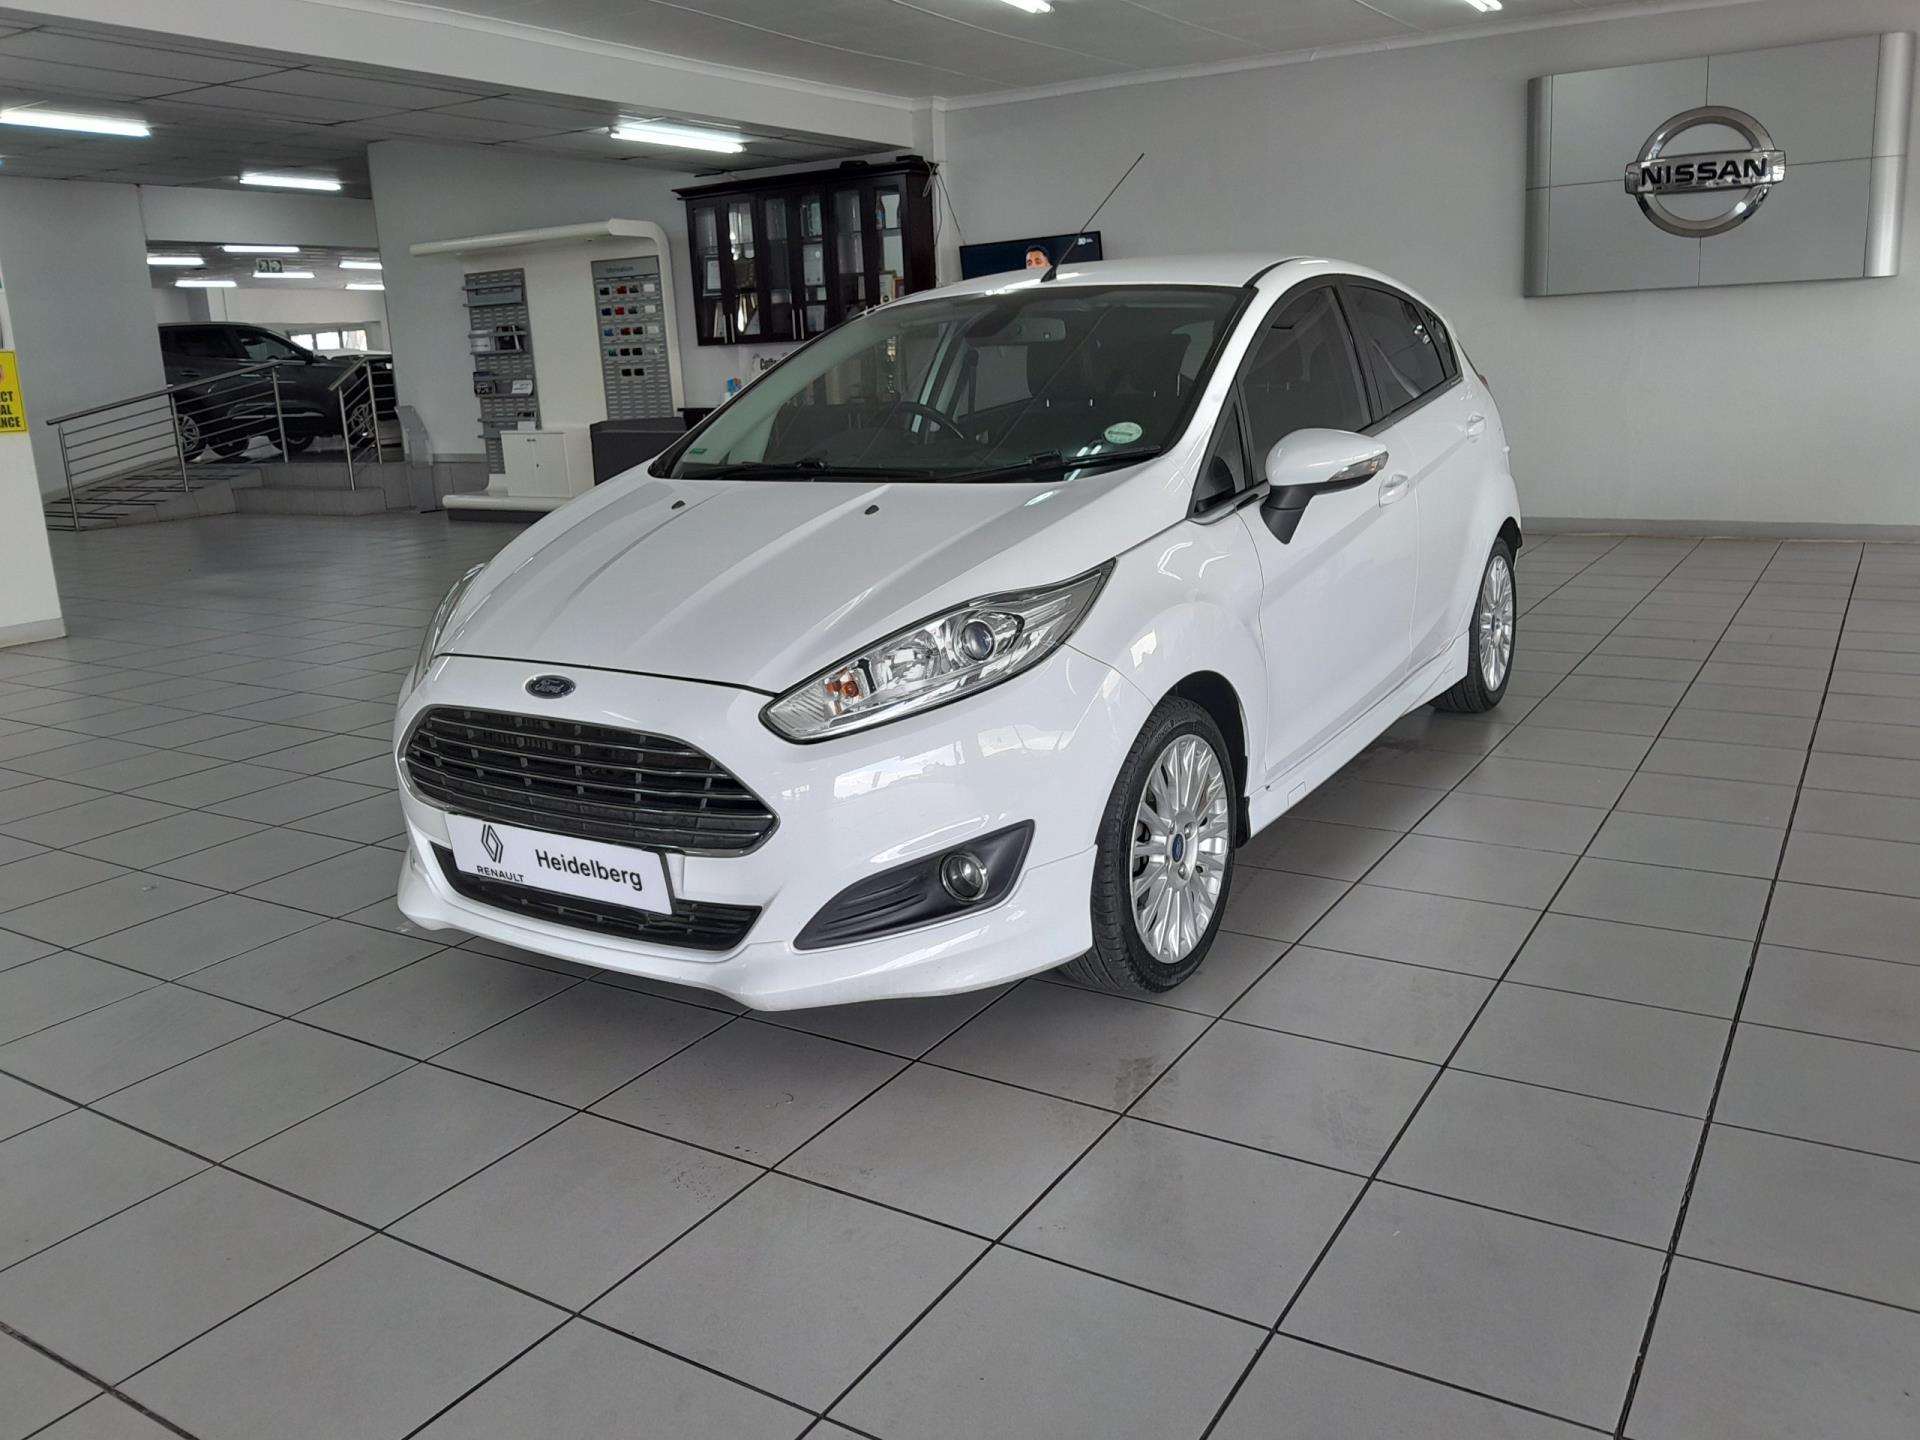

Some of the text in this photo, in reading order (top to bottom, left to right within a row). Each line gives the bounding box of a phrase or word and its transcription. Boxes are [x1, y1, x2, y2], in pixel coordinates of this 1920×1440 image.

[1641, 158, 1768, 185] NISSAN
[0, 416, 20, 428] NCE
[534, 679, 565, 694] Ford
[476, 865, 524, 883] RENAULT
[535, 849, 643, 892] Heidelberg
